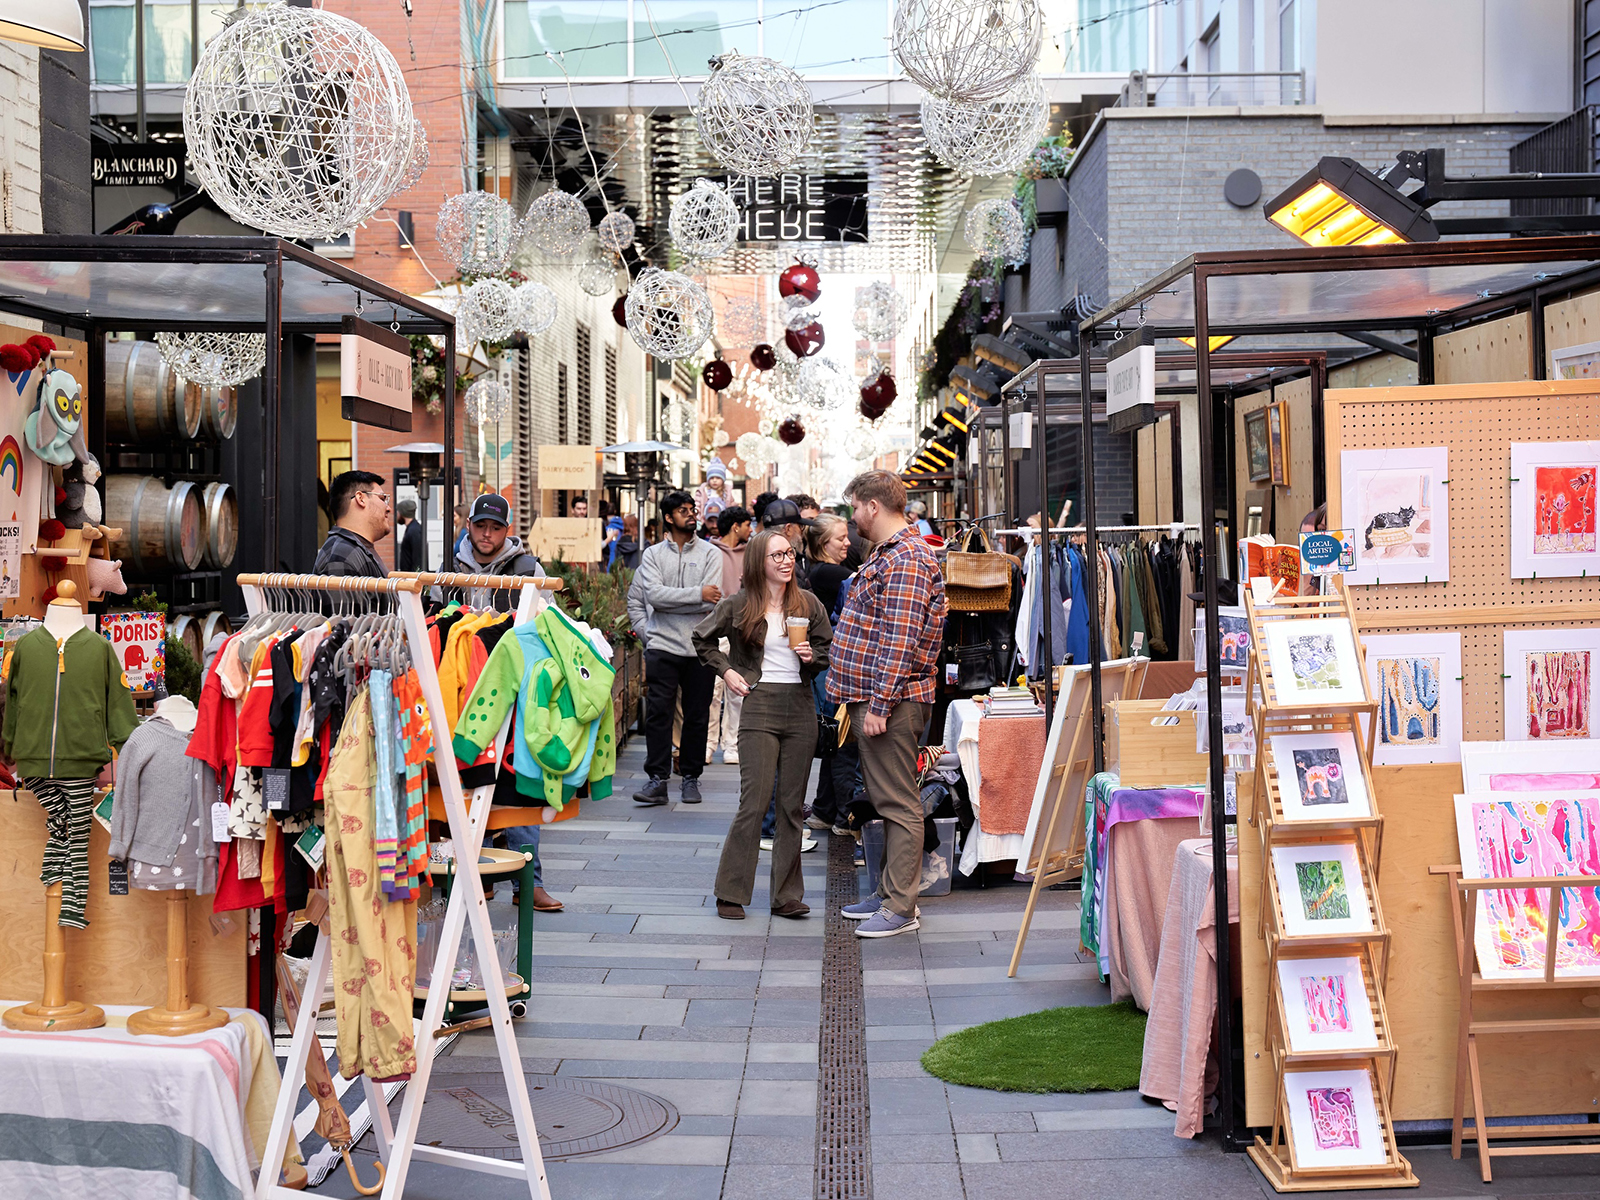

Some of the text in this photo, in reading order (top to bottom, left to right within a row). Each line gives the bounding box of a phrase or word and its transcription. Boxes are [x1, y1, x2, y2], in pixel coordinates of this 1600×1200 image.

[92, 157, 177, 180] BLANCHARD
[105, 176, 164, 185] FAMILY WINES
[727, 173, 825, 206] HERE
[1307, 540, 1333, 548] LOCAL
[1307, 546, 1334, 555] ARTIST
[1280, 562, 1299, 571] SILVER
[1278, 568, 1299, 579] FLAMES
[113, 622, 159, 644] DORIS
